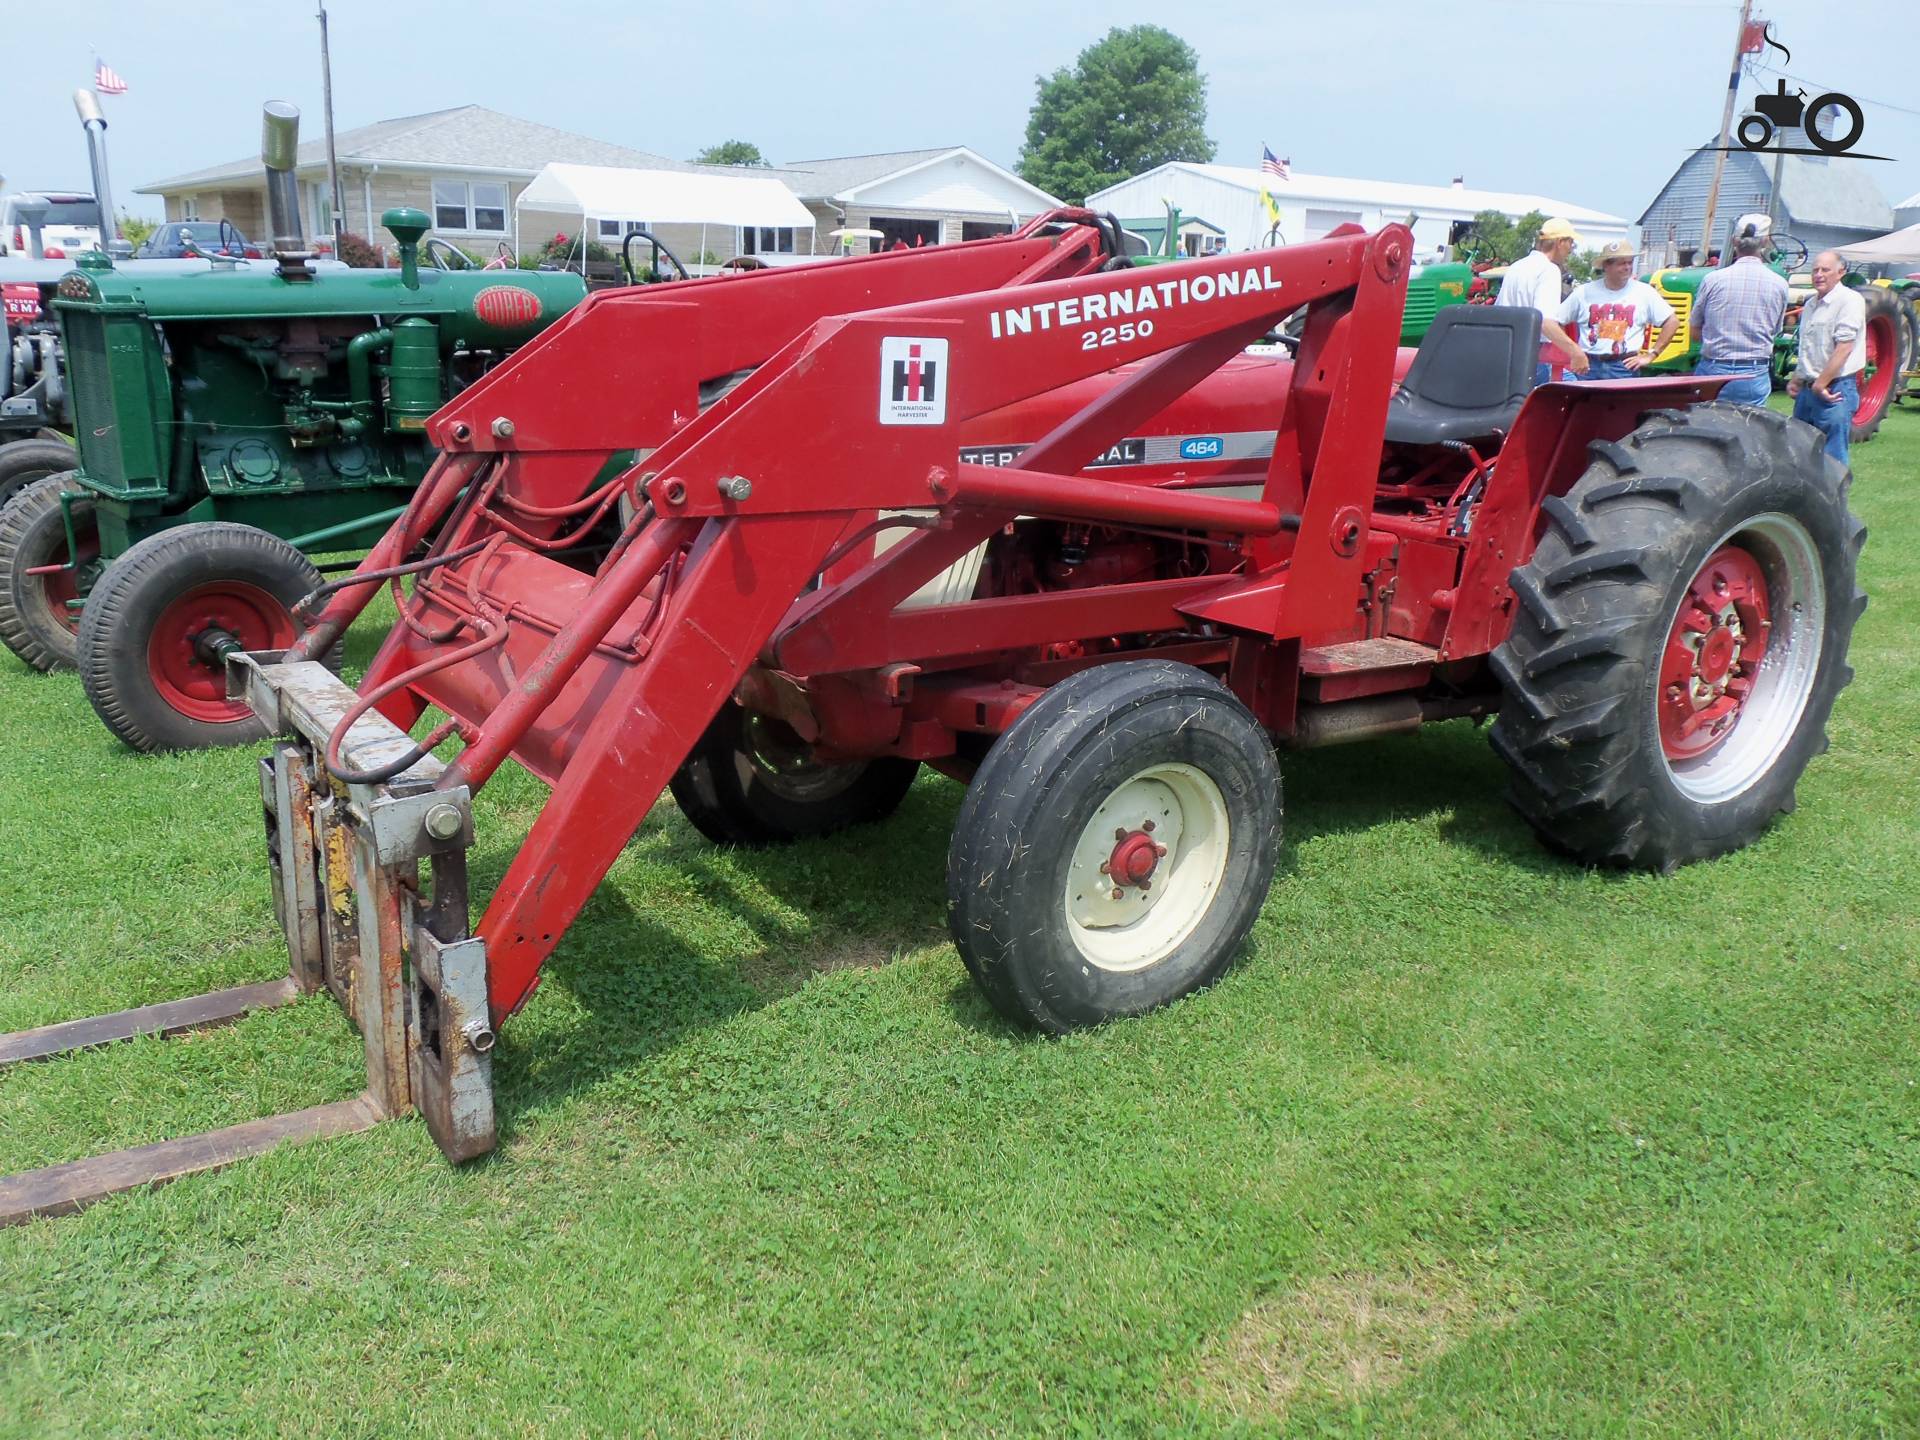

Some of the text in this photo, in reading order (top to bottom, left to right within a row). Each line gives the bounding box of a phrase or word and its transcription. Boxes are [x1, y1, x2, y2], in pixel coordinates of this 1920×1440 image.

[482, 292, 532, 327] HUBER
[990, 265, 1283, 339] INTERNATIONAL
[1081, 319, 1154, 351] 2250
[1185, 441, 1218, 455] 464
